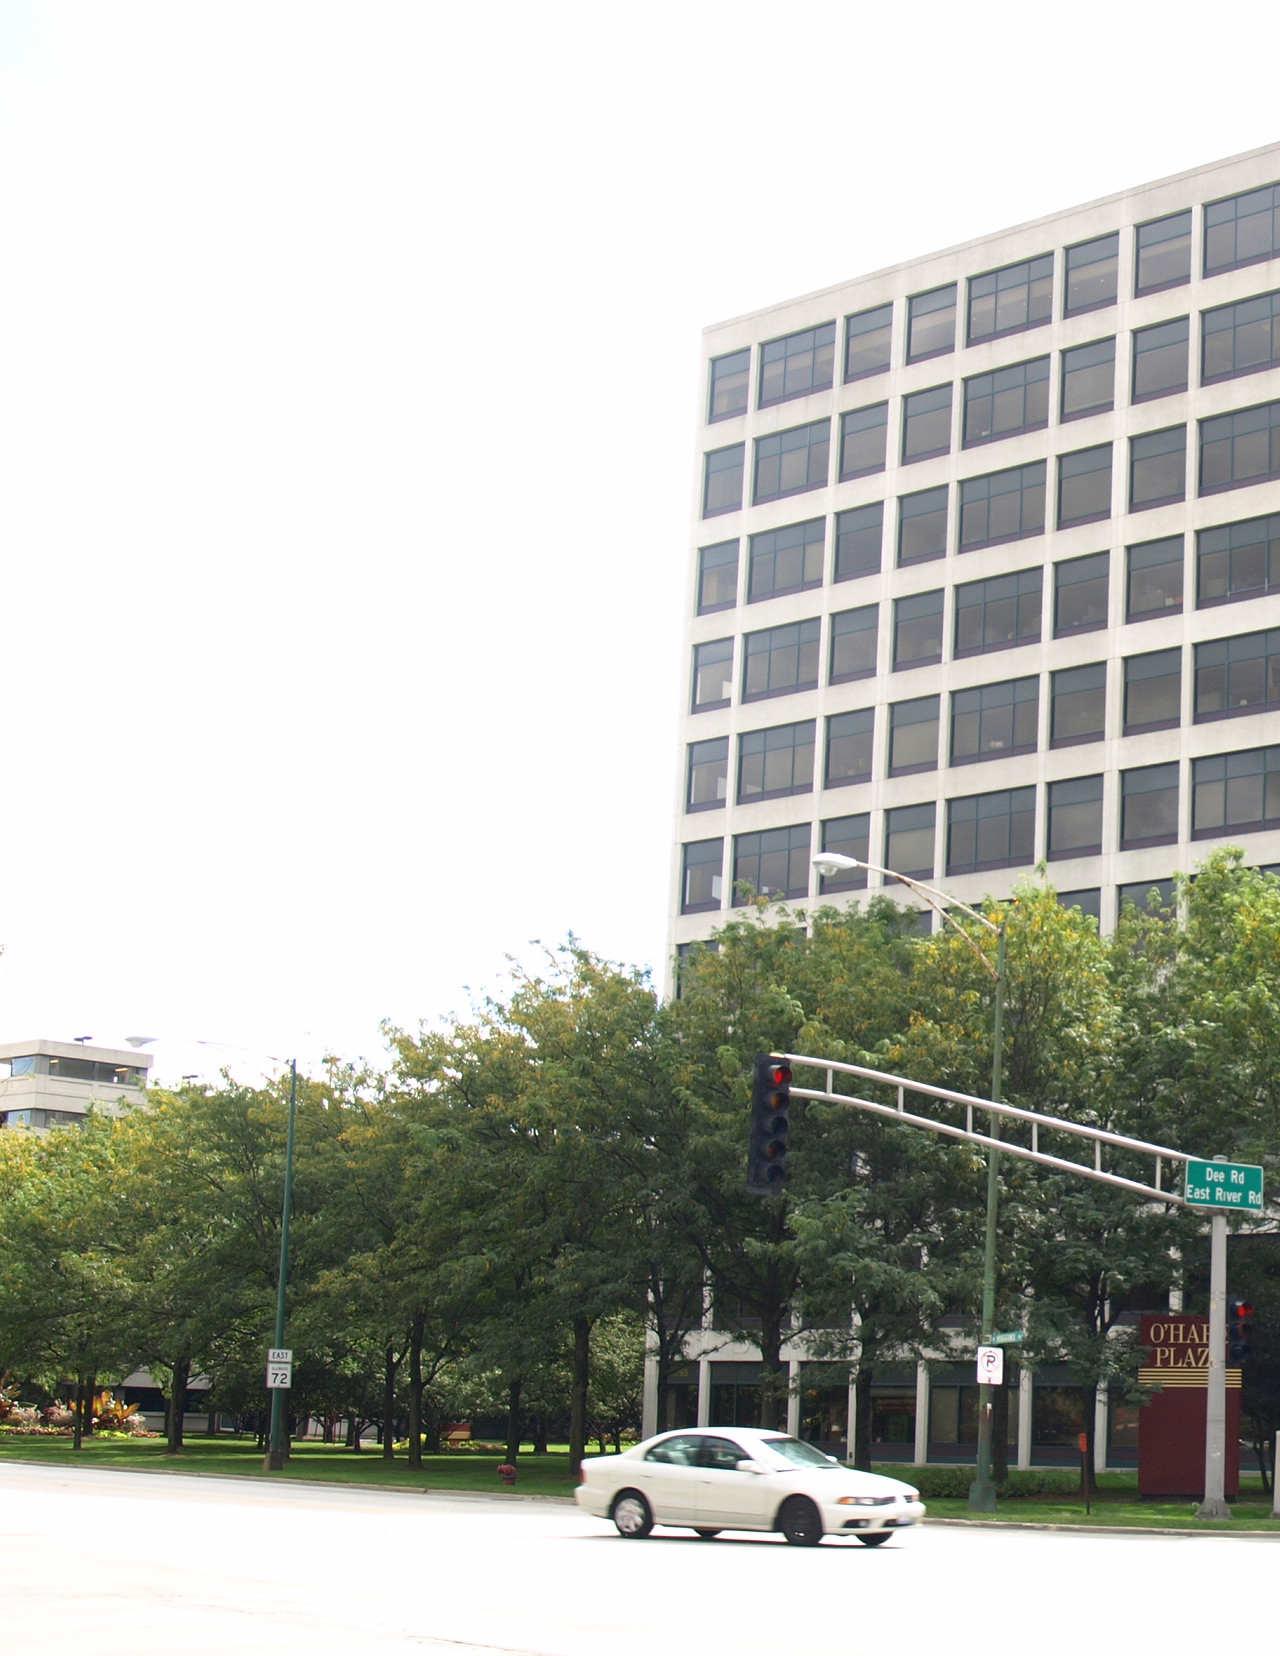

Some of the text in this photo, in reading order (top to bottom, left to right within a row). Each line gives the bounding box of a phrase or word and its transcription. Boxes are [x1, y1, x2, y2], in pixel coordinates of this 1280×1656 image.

[1206, 1168, 1245, 1184] Dee Rd
[1187, 1184, 1262, 1205] East River Rd
[272, 1351, 288, 1360] EAST
[1154, 1347, 1213, 1368] PLAZ
[271, 1372, 288, 1384] 72
